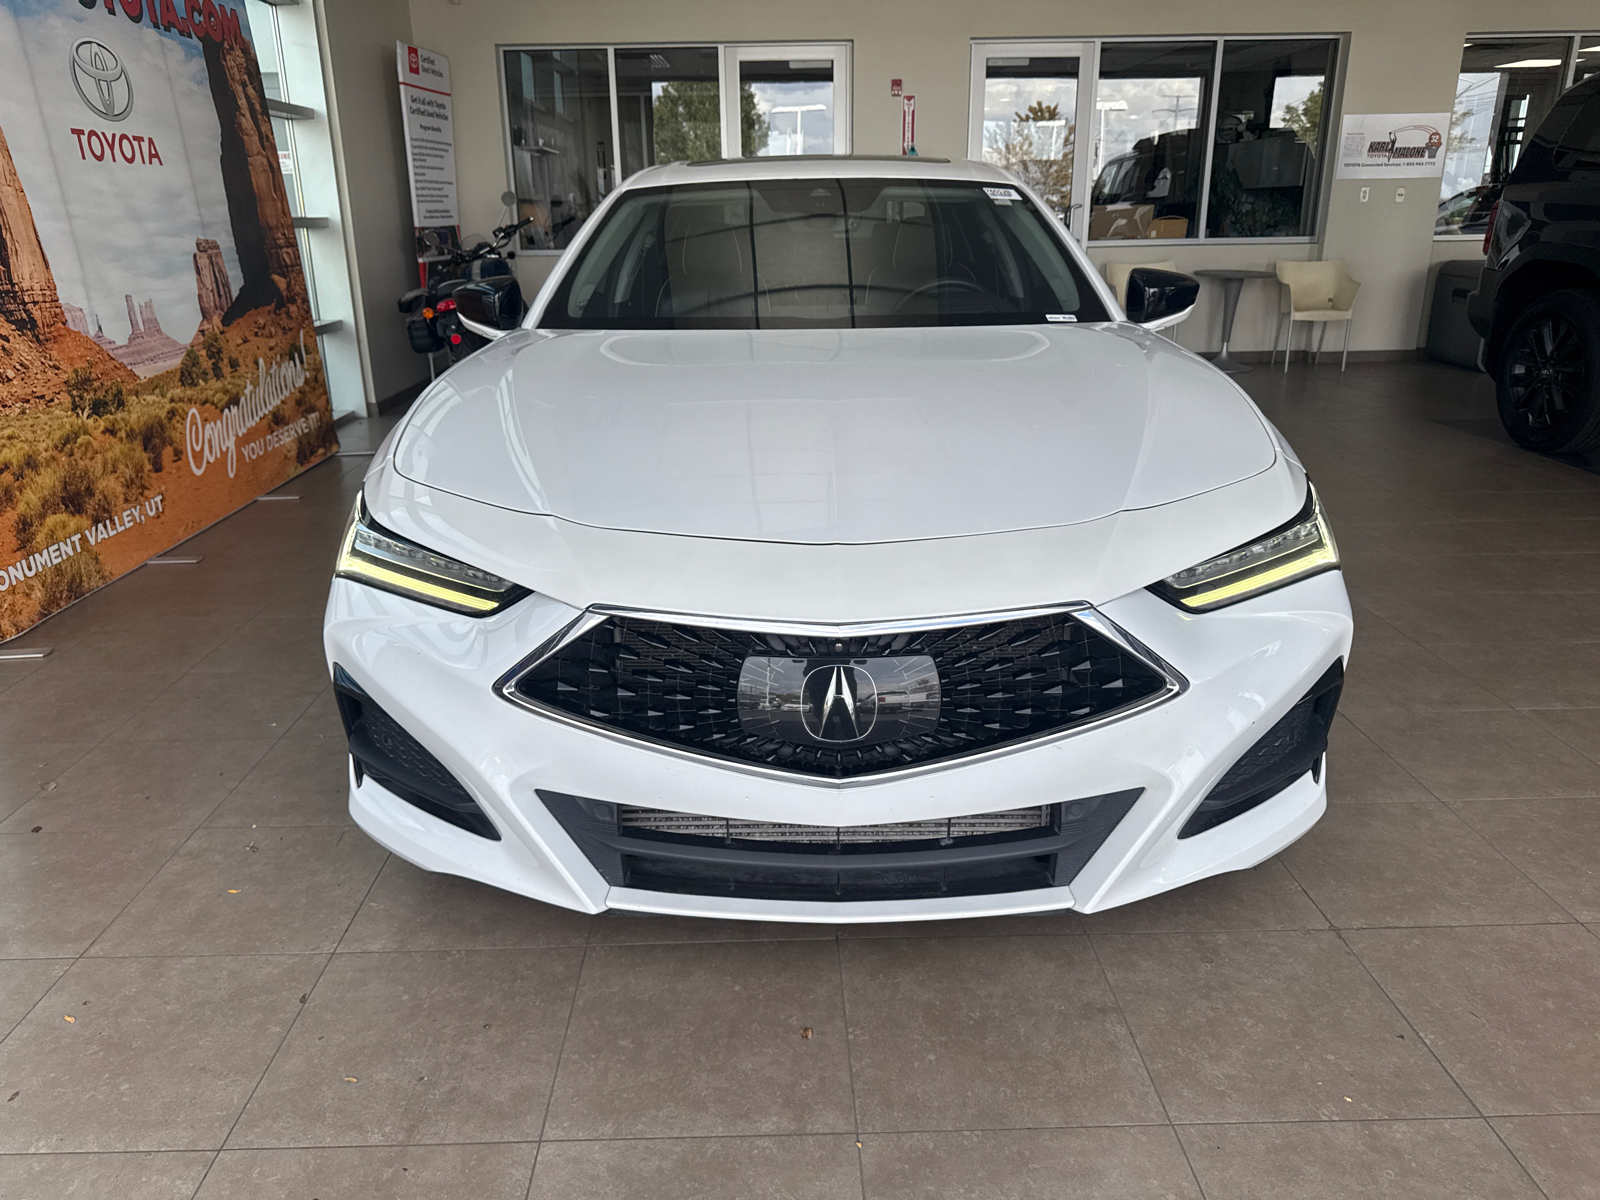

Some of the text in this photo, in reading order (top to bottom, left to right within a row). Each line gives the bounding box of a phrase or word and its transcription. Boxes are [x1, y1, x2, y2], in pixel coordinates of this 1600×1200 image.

[70, 127, 164, 166] TOYOTA
[1367, 141, 1427, 158] KARL MALONE
[1430, 134, 1439, 143] 32
[186, 330, 310, 478] Congratulations!
[241, 411, 321, 463] YOU DESERVE IT!
[85, 505, 145, 546] VALLEY,
[145, 495, 163, 517] UT
